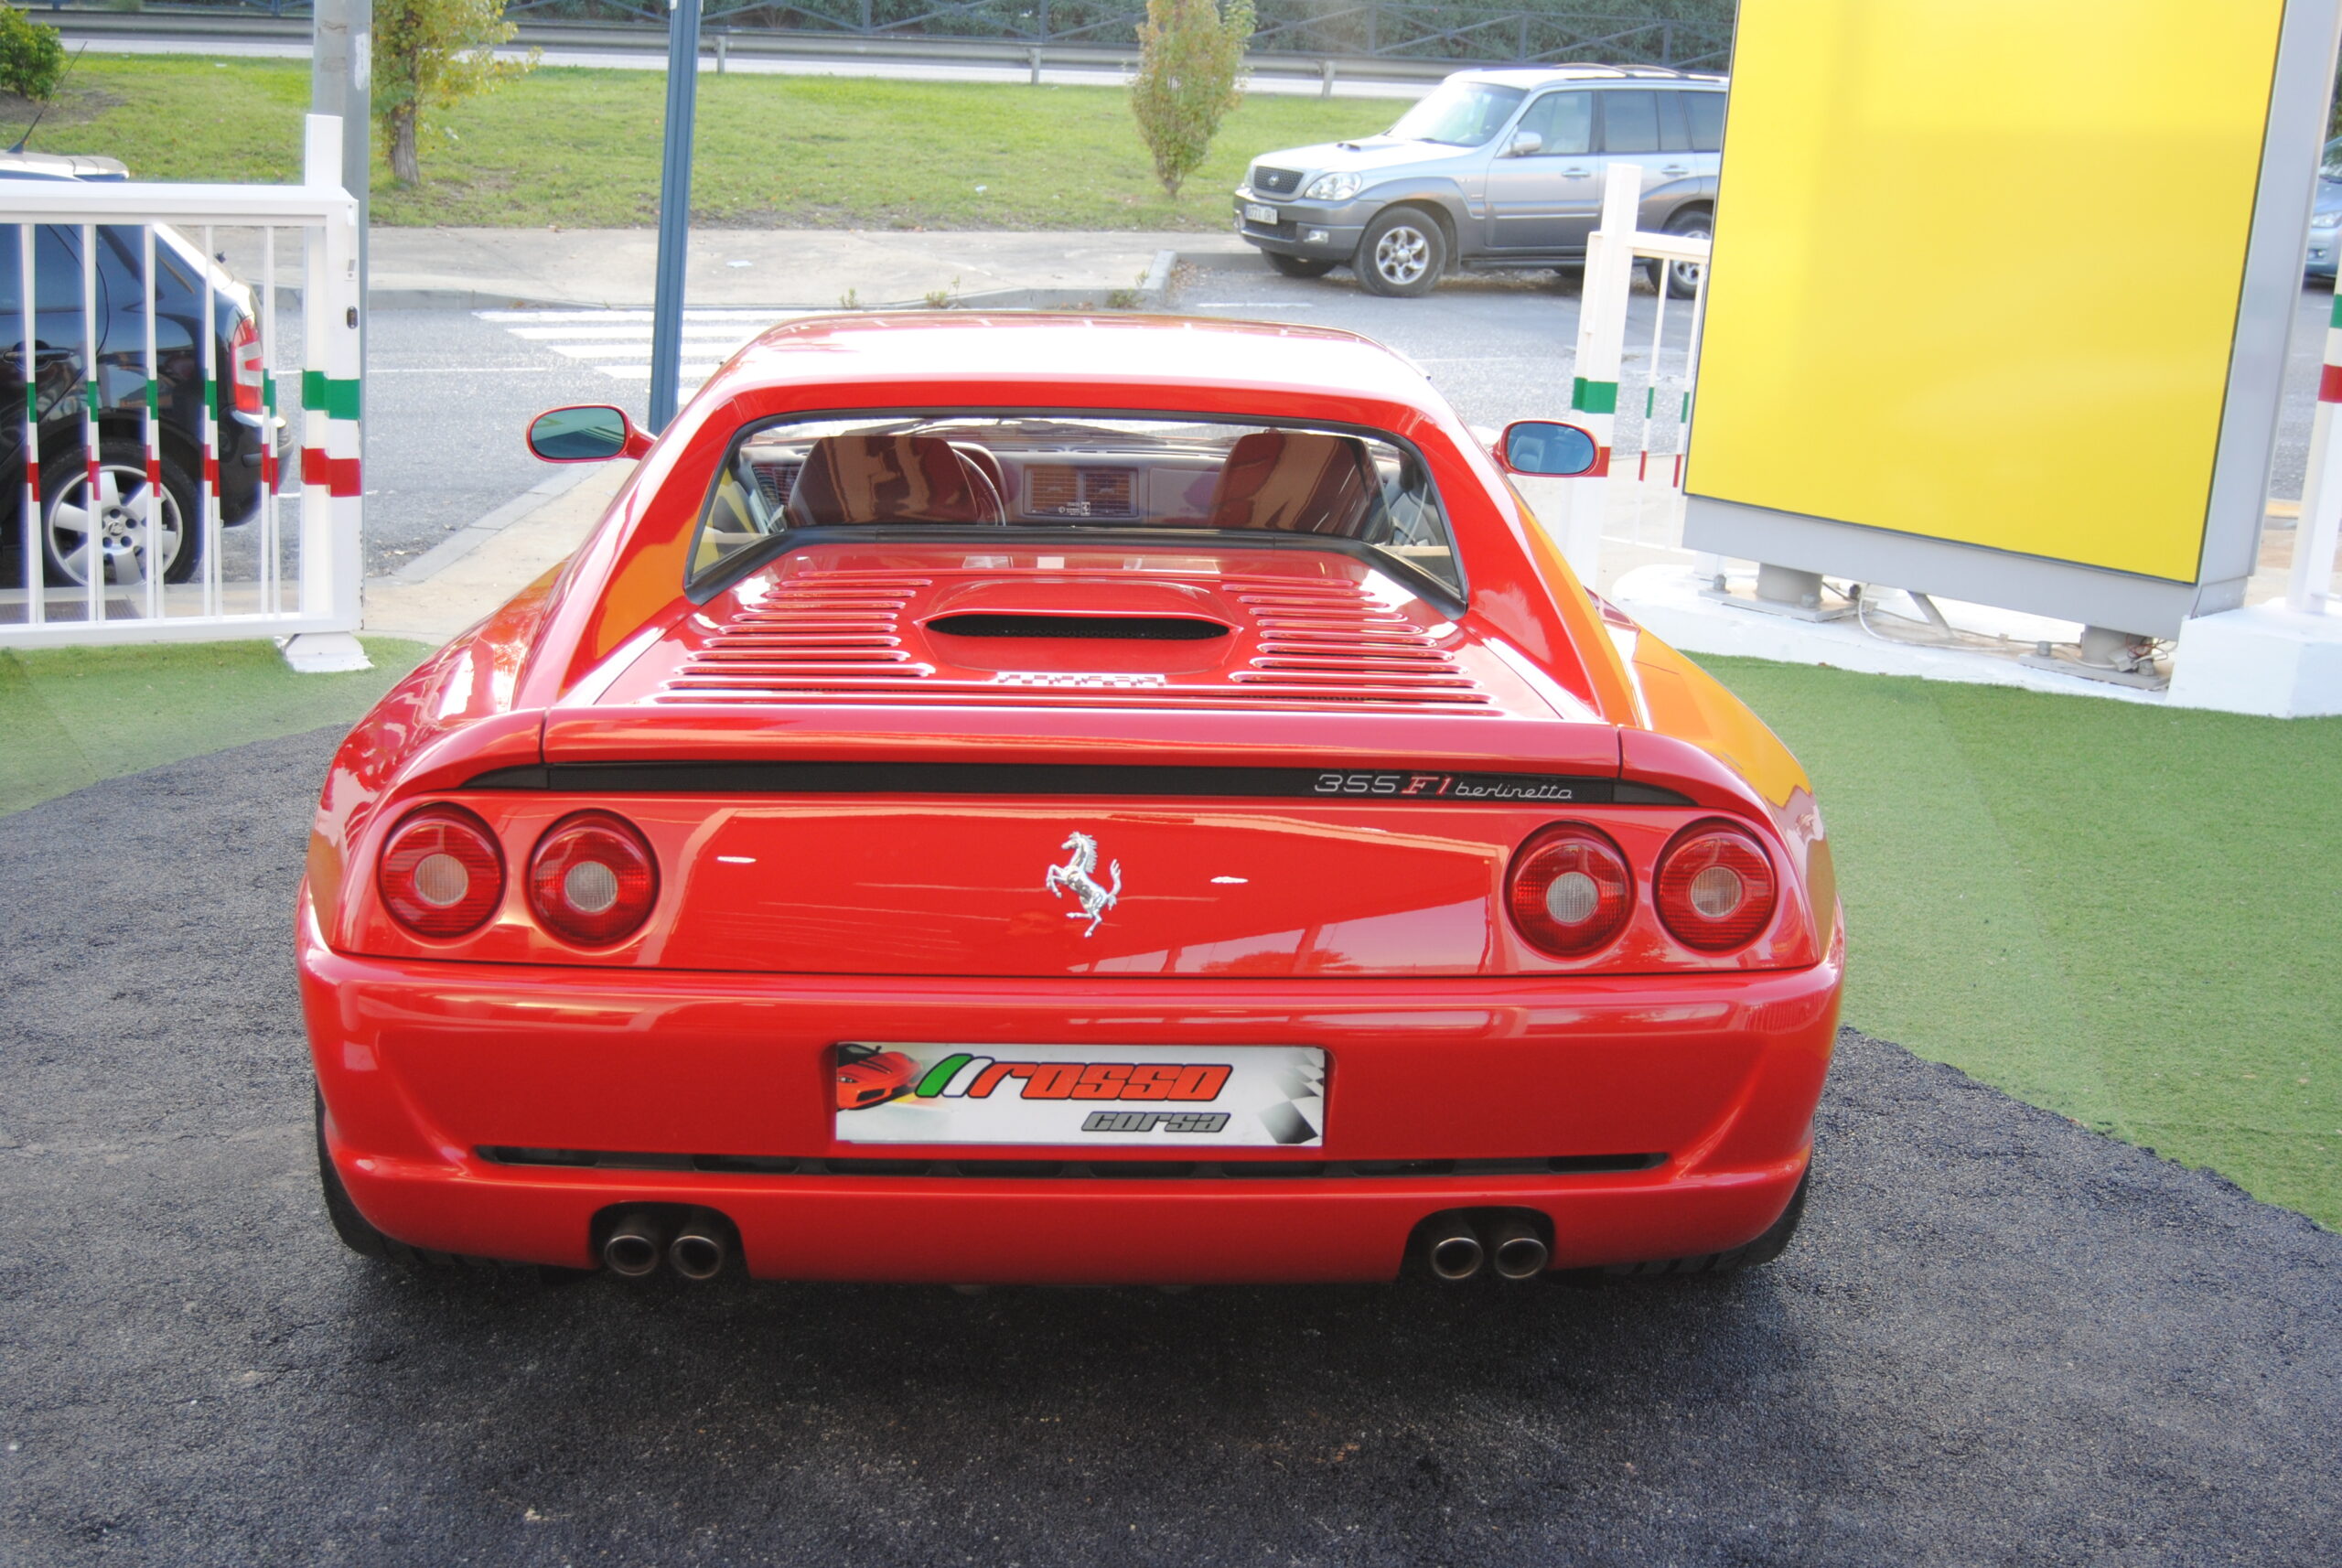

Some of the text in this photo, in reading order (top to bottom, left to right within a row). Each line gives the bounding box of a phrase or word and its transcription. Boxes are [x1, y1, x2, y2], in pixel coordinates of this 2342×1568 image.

[1314, 774, 1573, 800] 355 F1 berlinetta
[966, 1061, 1233, 1101] rosso
[1080, 1111, 1231, 1133] corsa
